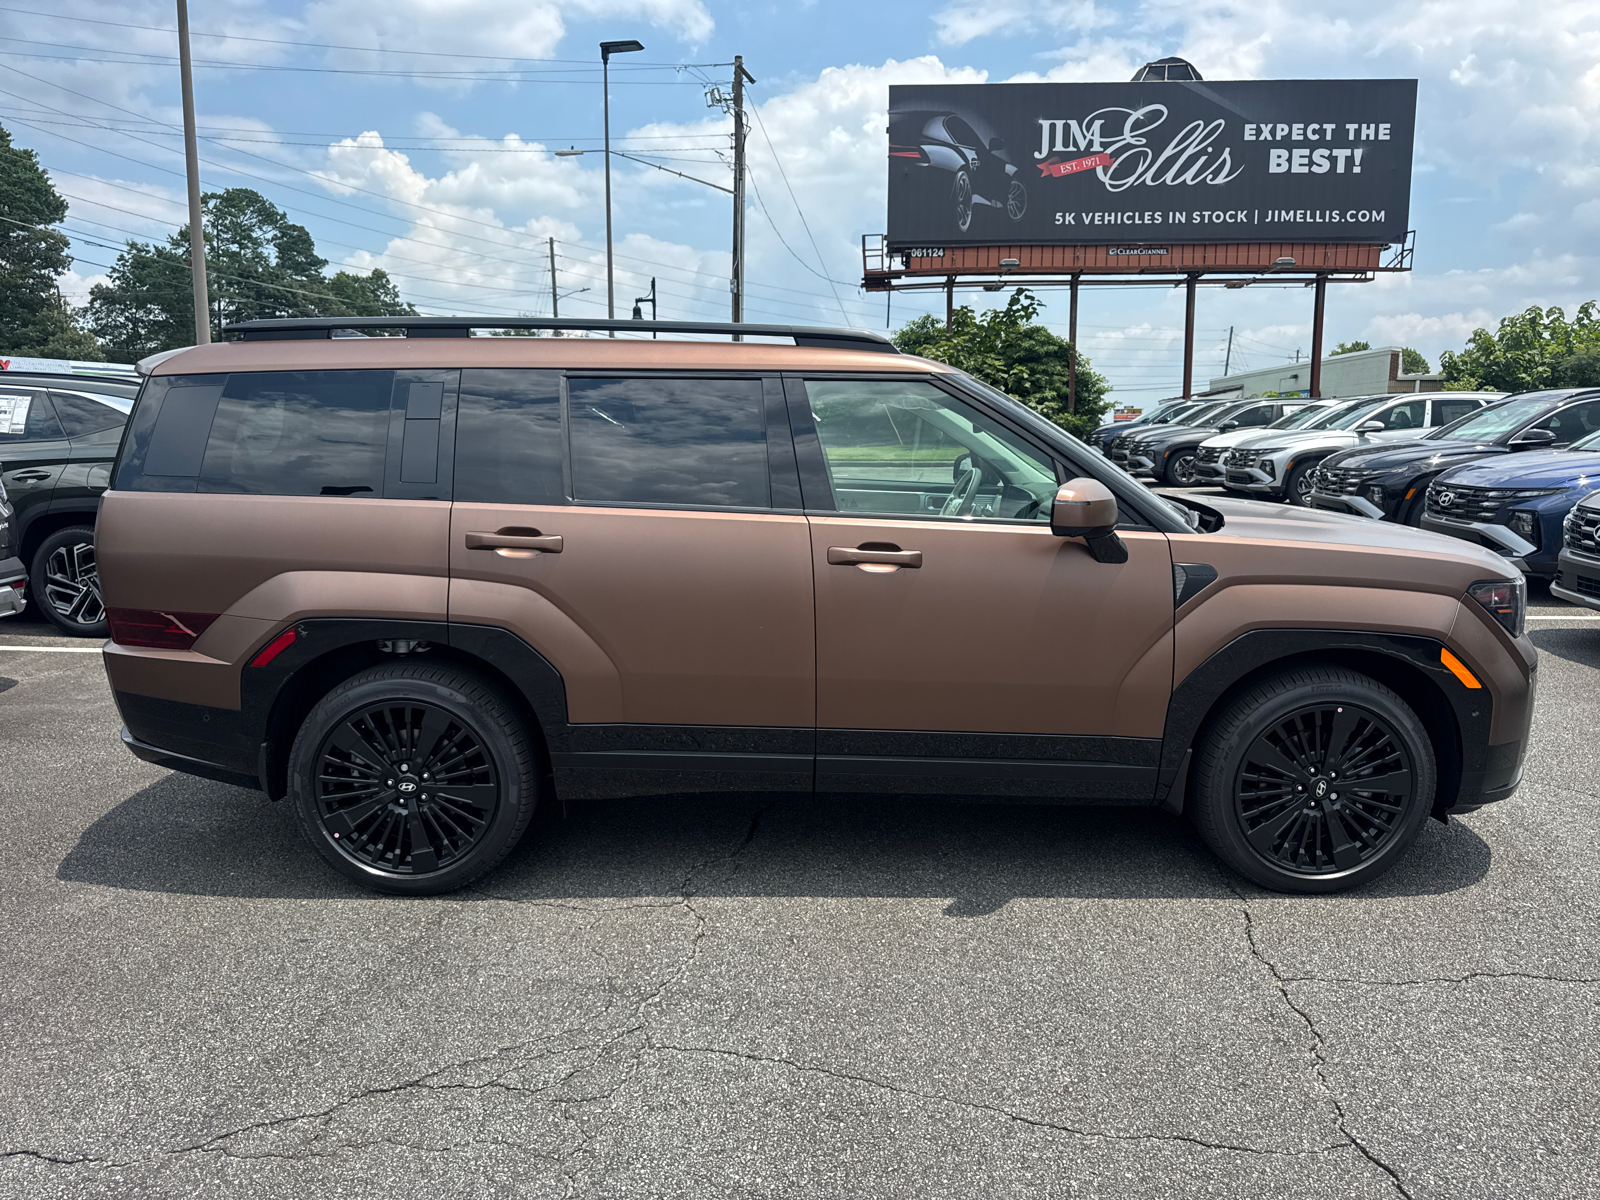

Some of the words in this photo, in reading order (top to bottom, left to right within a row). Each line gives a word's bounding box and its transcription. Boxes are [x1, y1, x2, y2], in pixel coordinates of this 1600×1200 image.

[1243, 123, 1336, 141] EXPECT
[1345, 123, 1391, 141] THE
[1033, 119, 1105, 159] JIM
[1082, 103, 1245, 192] Ellis
[1059, 161, 1080, 174] EST.
[1082, 156, 1100, 169] 1971
[1268, 148, 1363, 174] BEST!
[1054, 212, 1076, 225] 5K
[1081, 211, 1163, 225] VEHICLES
[1168, 211, 1187, 224] IN
[1191, 210, 1248, 224] STOCK
[1265, 209, 1386, 223] JIMELLIS.COM
[910, 248, 944, 258] 061124
